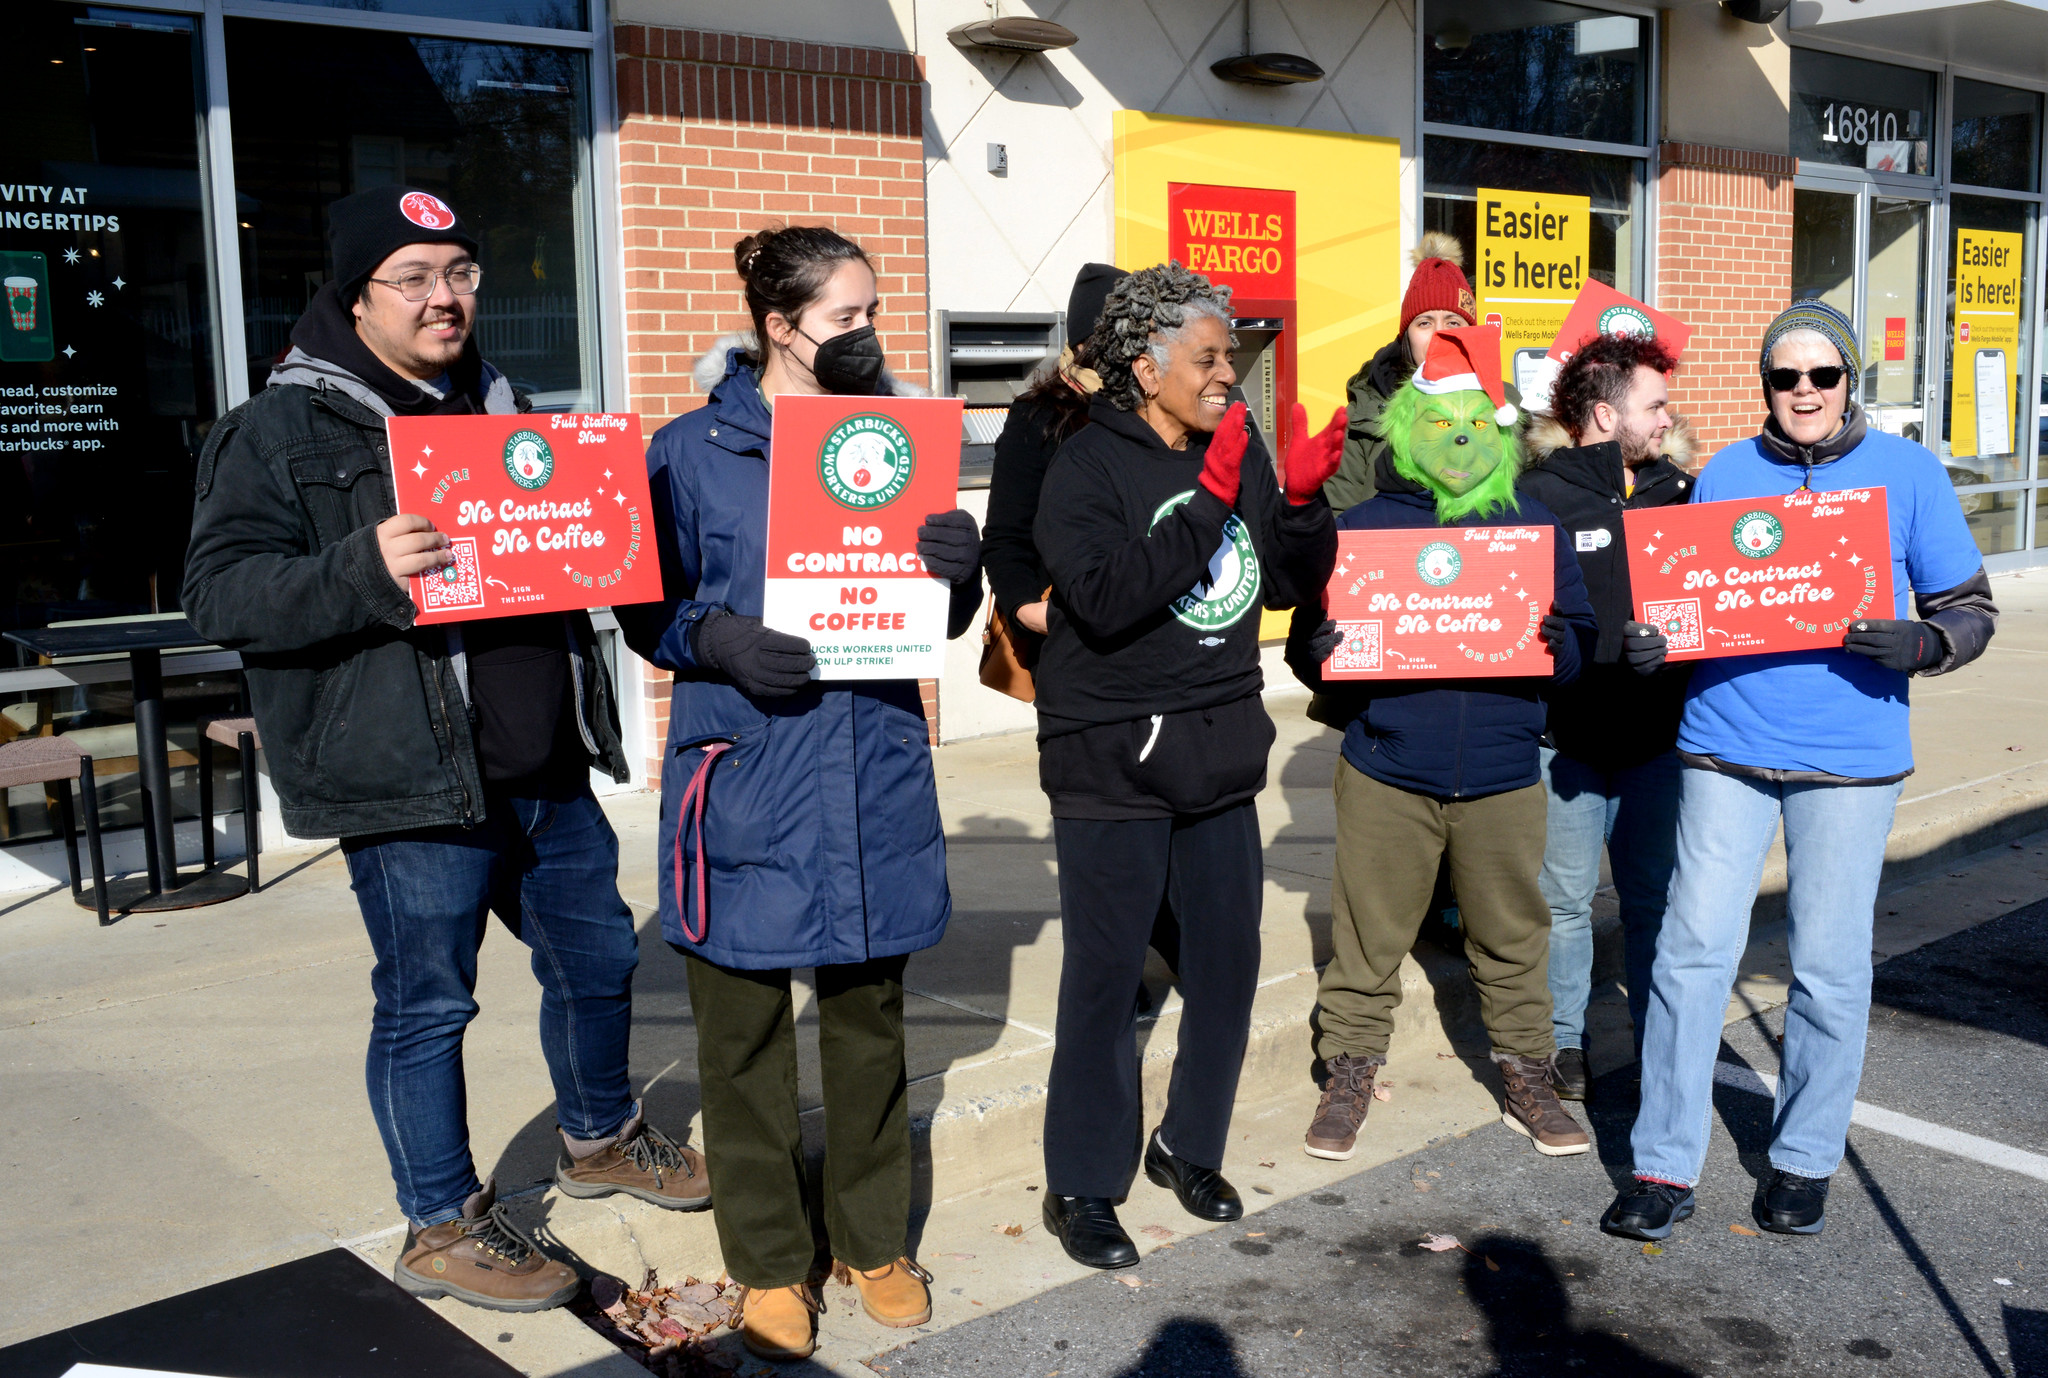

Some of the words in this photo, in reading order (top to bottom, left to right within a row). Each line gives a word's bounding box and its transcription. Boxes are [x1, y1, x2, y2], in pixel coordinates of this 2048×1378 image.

[1823, 103, 1898, 148] 16810
[60, 187, 88, 205] AT
[1183, 208, 1283, 242] WELLS
[1486, 201, 1569, 241] Easier
[1186, 243, 1282, 274] FARGO
[1962, 237, 2010, 267] Easier
[1485, 248, 1506, 288] is
[1514, 251, 1581, 291] here!
[1960, 274, 1973, 303] is
[1977, 276, 2016, 305] here!
[1505, 316, 1523, 326] Check
[1525, 317, 1535, 326] out
[1538, 317, 1548, 326] the
[1611, 307, 1653, 332] STARBUCKS
[1505, 330, 1522, 339] Wells
[1523, 330, 1540, 341] Fargo
[1886, 330, 1905, 338] WELLS
[1886, 339, 1904, 348] FARGO
[42, 383, 118, 397] customize
[0, 402, 67, 416] avorites,
[70, 404, 104, 414] earn
[11, 420, 40, 433] and
[43, 422, 83, 432] more
[86, 418, 119, 431] with
[551, 414, 578, 429] Full
[582, 414, 628, 431] Staffing
[831, 418, 906, 447] STARBUCKS
[72, 439, 105, 452] app.
[507, 431, 547, 451] STARBUCKS
[577, 430, 607, 445] Now
[506, 456, 533, 489] WORKERS
[537, 456, 553, 486] UNITED
[823, 453, 867, 506] WORKERS
[875, 455, 910, 503] UNITED
[431, 468, 470, 504] WE'RE
[1783, 494, 1813, 508] Full
[1817, 489, 1871, 504] Staffing
[457, 500, 494, 526] No
[499, 498, 592, 522] Contract
[1736, 511, 1777, 530] STARBUCKS
[1811, 505, 1844, 518] Now
[492, 528, 531, 556] No
[536, 523, 606, 551] Coffee
[843, 526, 882, 546] NO
[1463, 529, 1490, 541] Full
[1494, 529, 1540, 542] Staffing
[1734, 533, 1760, 558] WORKERS
[1764, 530, 1782, 556] UNITED
[572, 571, 593, 588] ON
[598, 568, 622, 588] ULP
[623, 506, 641, 570] STRIKE!
[1420, 542, 1458, 558] STARBUCKS
[1487, 542, 1517, 553] Now
[1660, 545, 1697, 575] WE'RE
[1348, 570, 1384, 596] WE'RE
[1418, 561, 1440, 586] WORKERS
[1443, 560, 1461, 584] UNITED
[1683, 569, 1720, 590] No
[1724, 561, 1822, 585] Contract
[512, 586, 531, 594] SIGN
[1222, 557, 1255, 612] UNITED
[517, 594, 545, 603] PLEDGE
[840, 586, 878, 605] NO
[1368, 593, 1402, 612] No
[1405, 593, 1493, 611] Contract
[1715, 589, 1754, 612] No
[1760, 582, 1835, 606] Coffee
[1795, 621, 1817, 634] ON
[1824, 617, 1850, 634] ULP
[1853, 565, 1877, 618] STRIKE!
[809, 612, 906, 631] COFFEE
[1395, 614, 1431, 635] No
[1435, 612, 1503, 633] Coffee
[1464, 649, 1484, 662] ON
[1489, 648, 1514, 662] ULP
[1516, 600, 1539, 650] STRIKE!
[811, 646, 839, 654] UCKS
[842, 645, 893, 654] WORKERS
[896, 644, 932, 653] UNITED
[1737, 639, 1765, 647] PLEDGE
[815, 658, 831, 666] ON
[856, 657, 894, 665] STRIKE!
